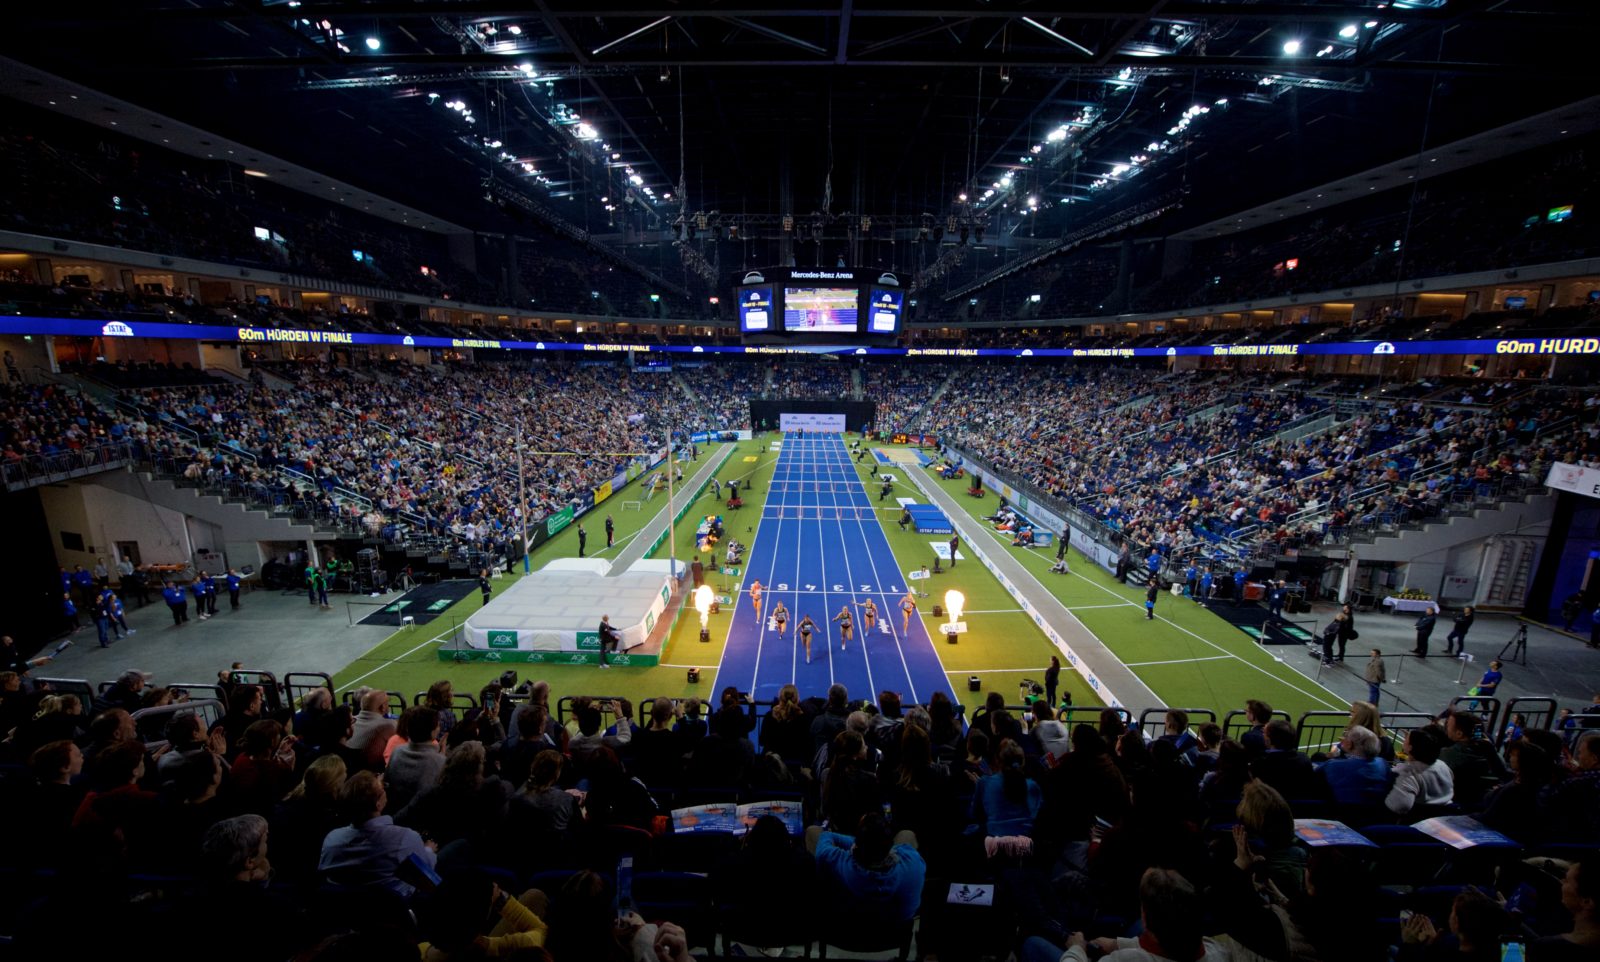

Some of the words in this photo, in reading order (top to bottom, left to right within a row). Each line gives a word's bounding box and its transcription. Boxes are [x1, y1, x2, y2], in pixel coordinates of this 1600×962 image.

[791, 271, 835, 279] Mercedes-Benz
[238, 328, 264, 340] 60m
[266, 328, 309, 342] HÜRDEN
[310, 331, 321, 342] W
[322, 332, 353, 343] FINALE
[1214, 347, 1228, 355] 60m
[1229, 345, 1258, 355] HÜRDEN
[1259, 345, 1269, 355] W
[1269, 345, 1299, 355] FINALE
[1496, 340, 1536, 354] 60m
[1539, 338, 1600, 354] HURD
[833, 584, 845, 592] 3
[860, 584, 872, 592] 2
[493, 634, 513, 643] AOK
